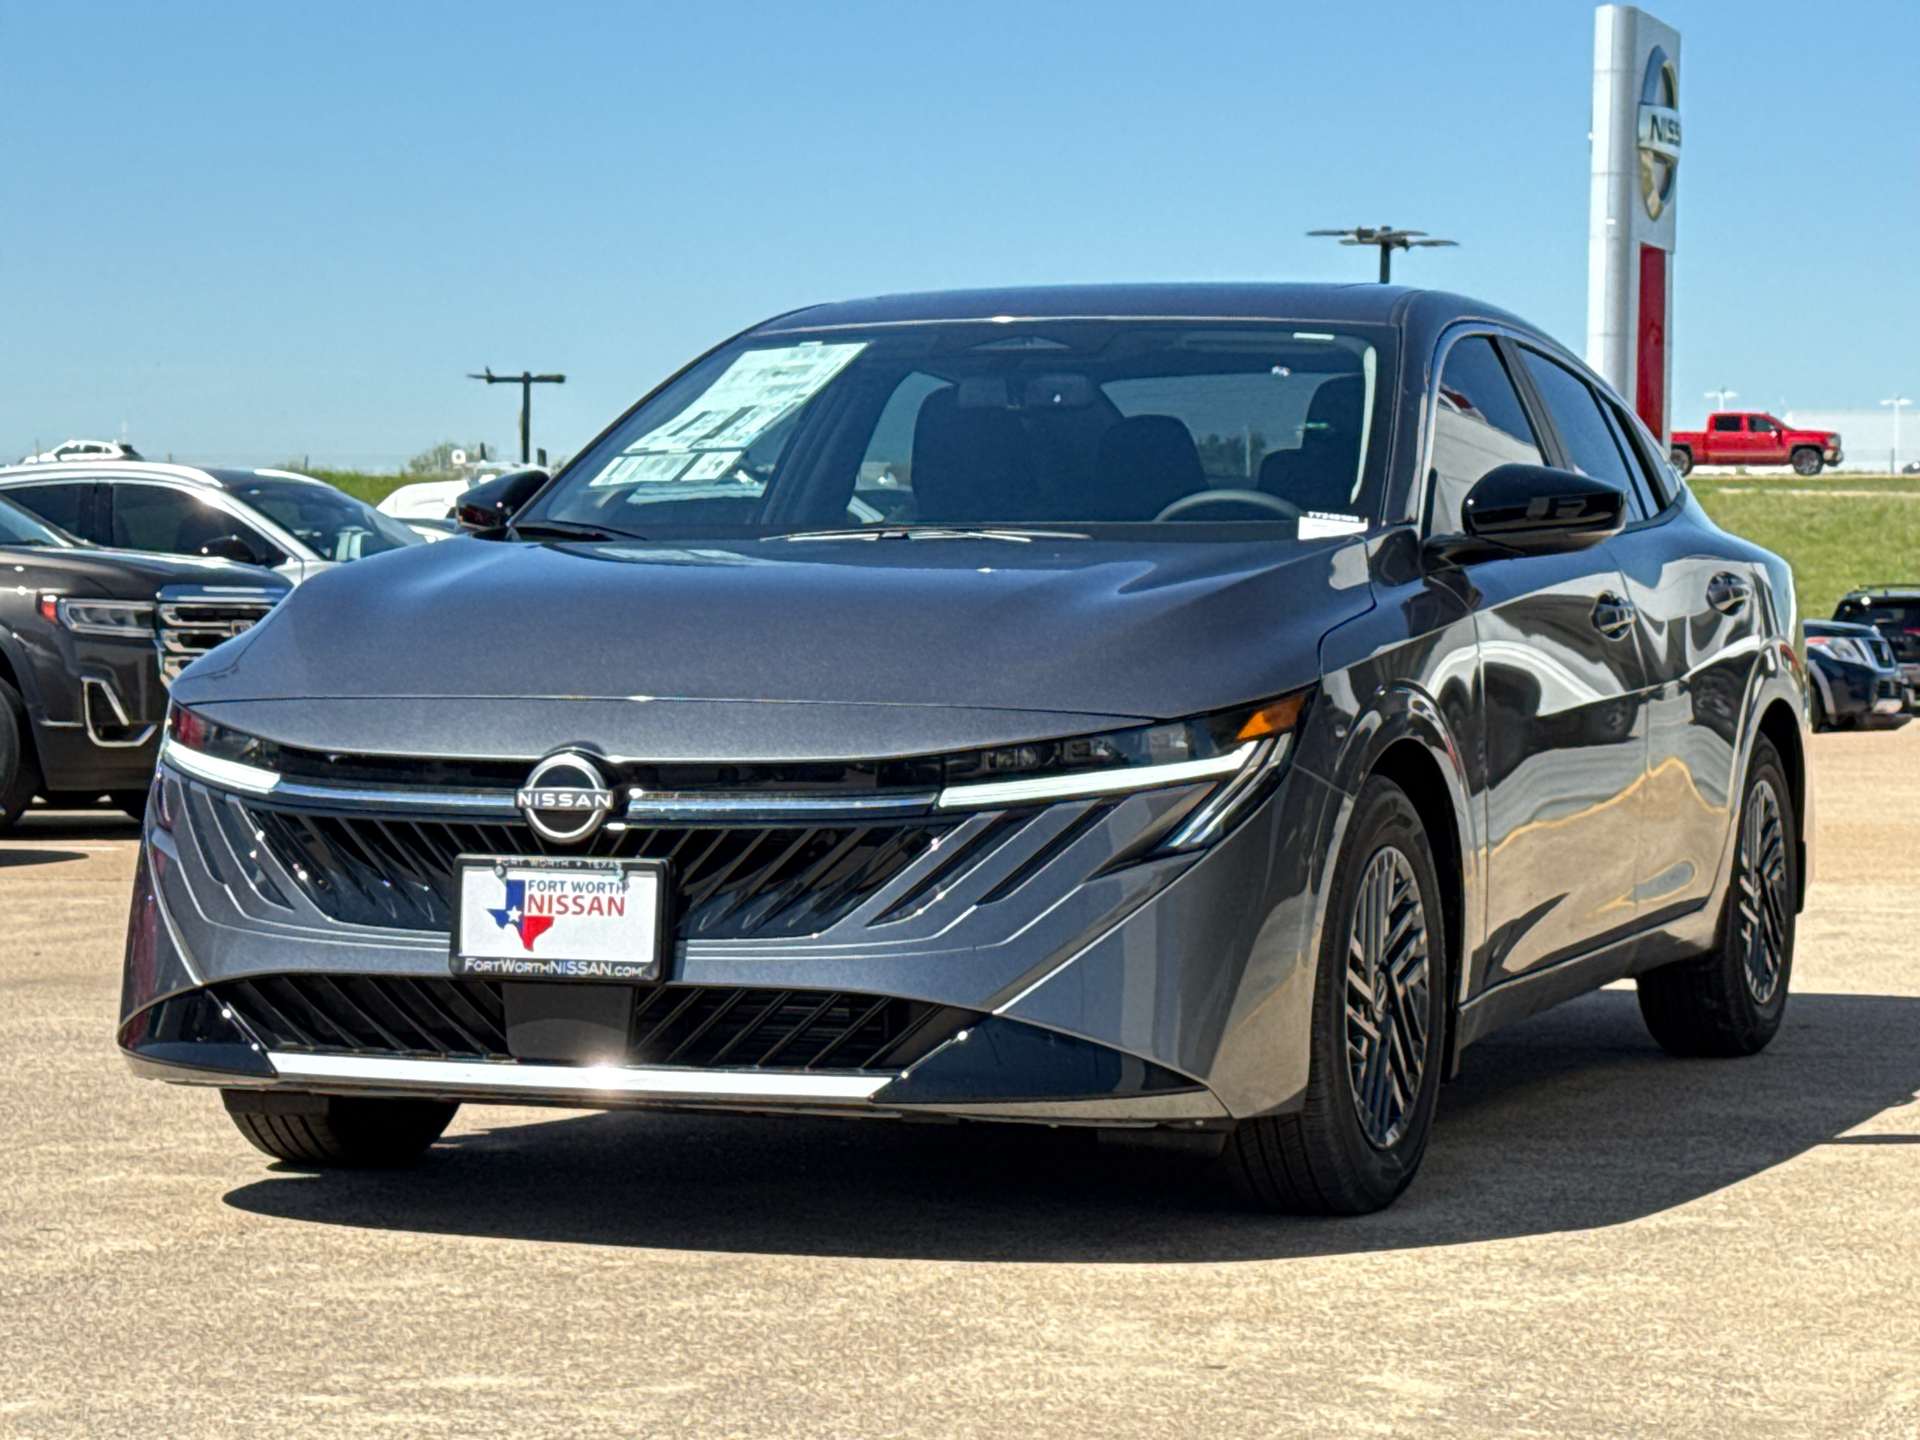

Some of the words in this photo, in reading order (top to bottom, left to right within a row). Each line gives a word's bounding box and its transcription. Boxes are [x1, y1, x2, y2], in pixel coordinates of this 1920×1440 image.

[517, 792, 612, 807] NISSAN
[496, 859, 523, 867] FORT
[530, 859, 569, 868] WORTH
[587, 861, 622, 869] TEXAS
[528, 880, 567, 892] FORT
[571, 881, 626, 895] WORTH
[527, 895, 625, 917] NISSAN
